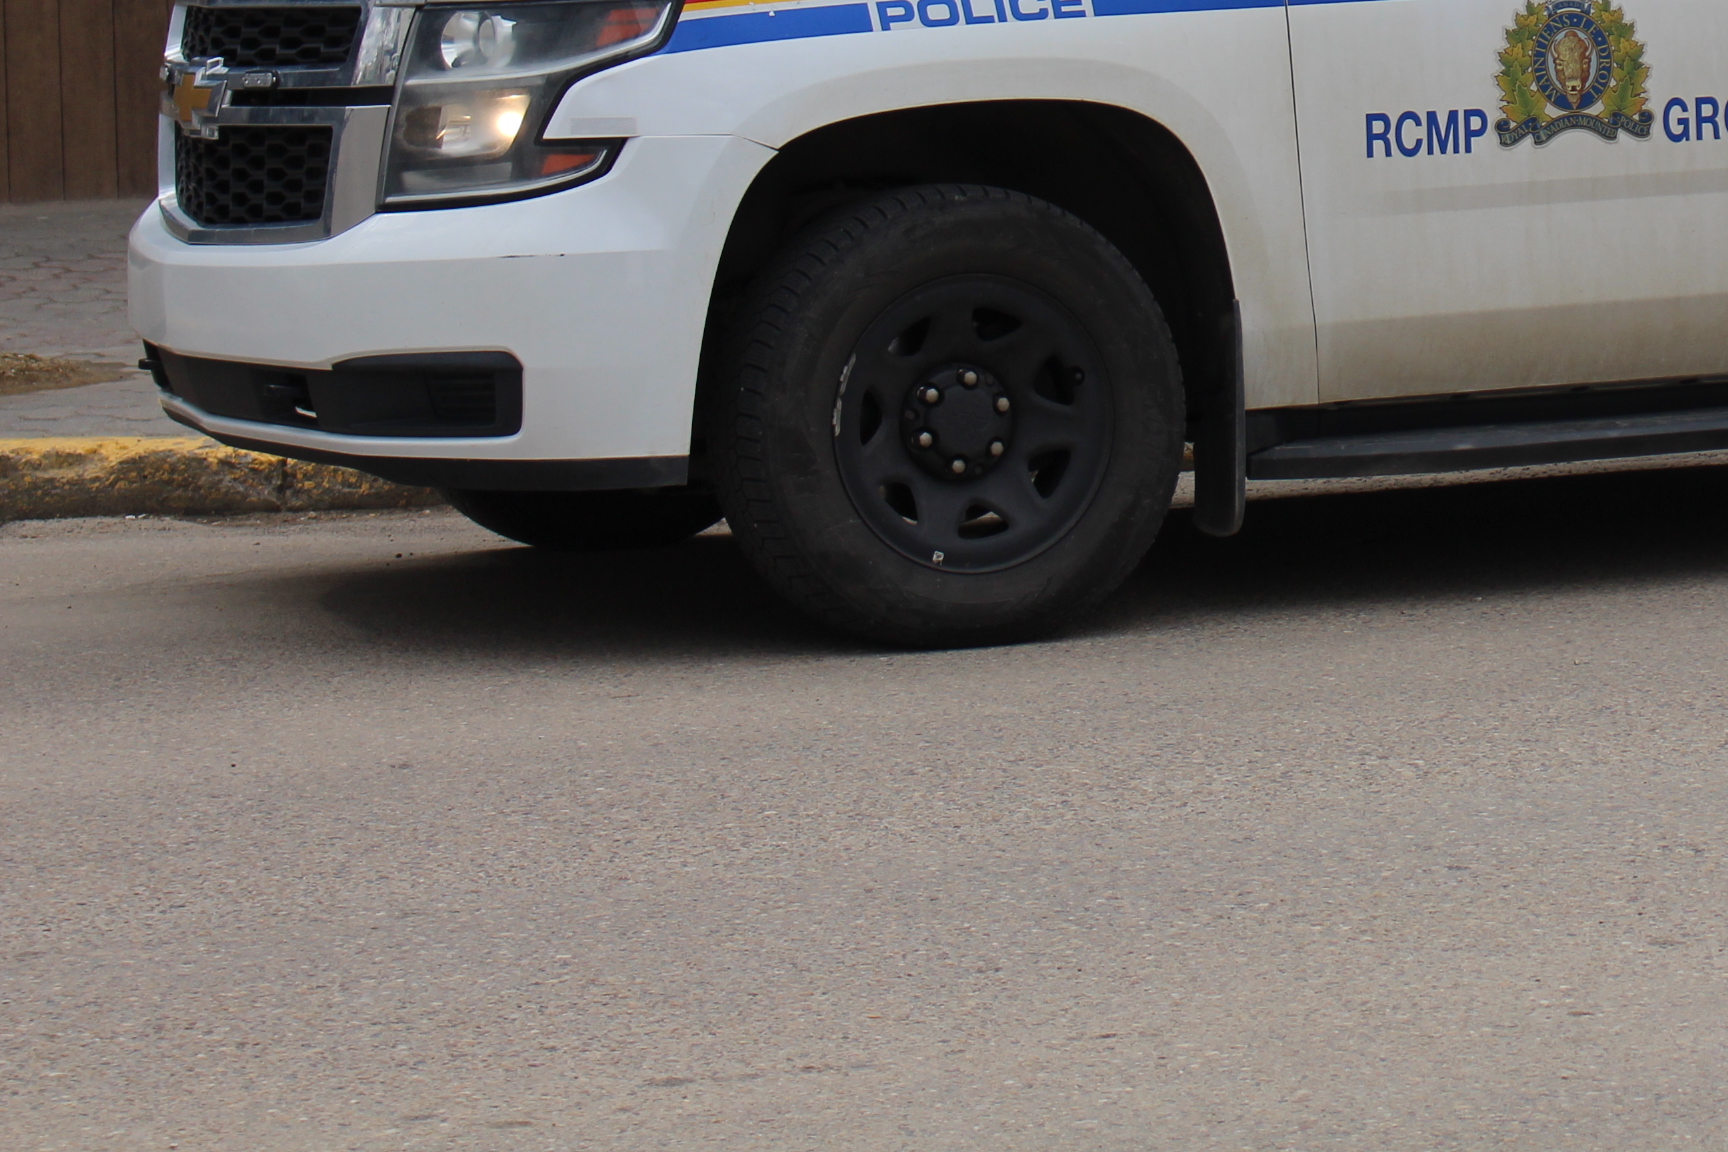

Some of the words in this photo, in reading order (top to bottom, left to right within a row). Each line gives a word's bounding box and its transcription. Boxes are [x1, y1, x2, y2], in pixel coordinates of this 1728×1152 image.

[1534, 13, 1571, 103] MAINTIENS
[1580, 17, 1598, 38] LE
[1590, 44, 1610, 103] DROIT
[1365, 108, 1489, 159] RCMP
[1620, 117, 1651, 136] POLICE
